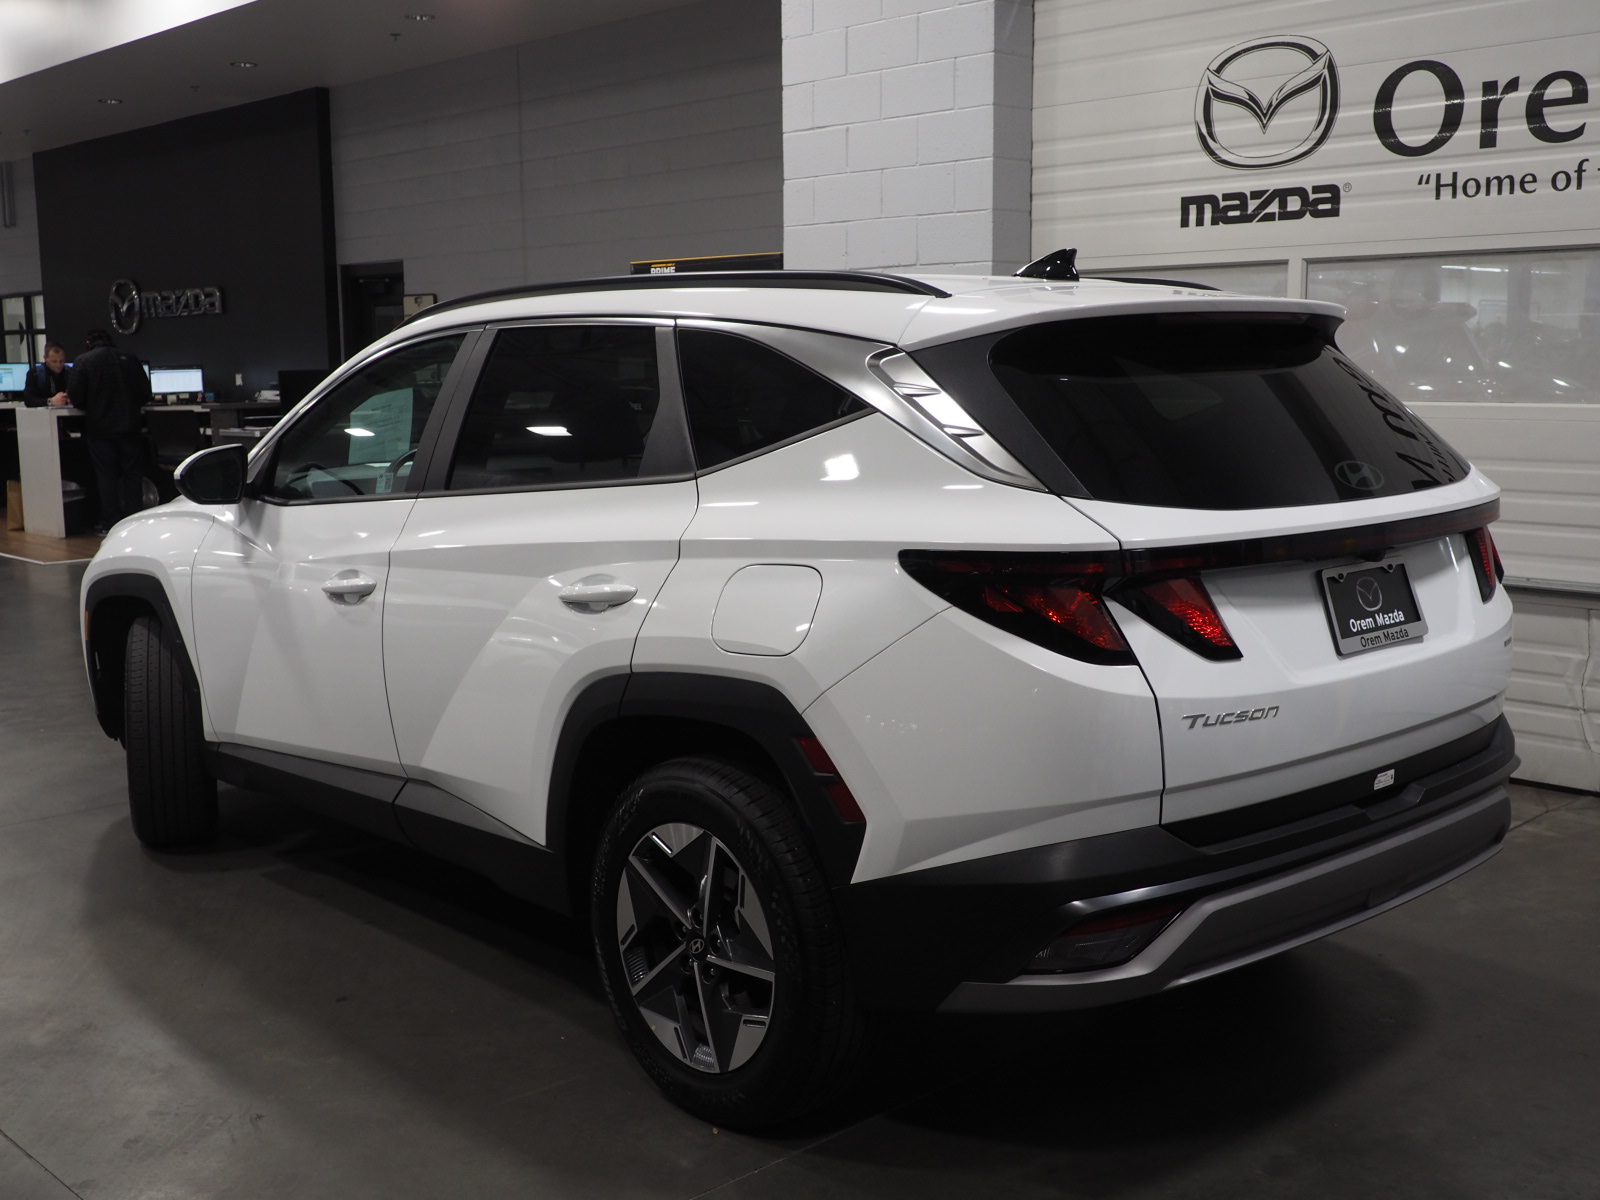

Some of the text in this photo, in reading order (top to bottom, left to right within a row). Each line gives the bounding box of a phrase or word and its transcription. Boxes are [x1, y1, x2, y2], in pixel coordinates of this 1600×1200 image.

[1551, 158, 1590, 192] of
[1349, 608, 1406, 633] Orem Mazda
[1360, 627, 1410, 648] Orem Mazda
